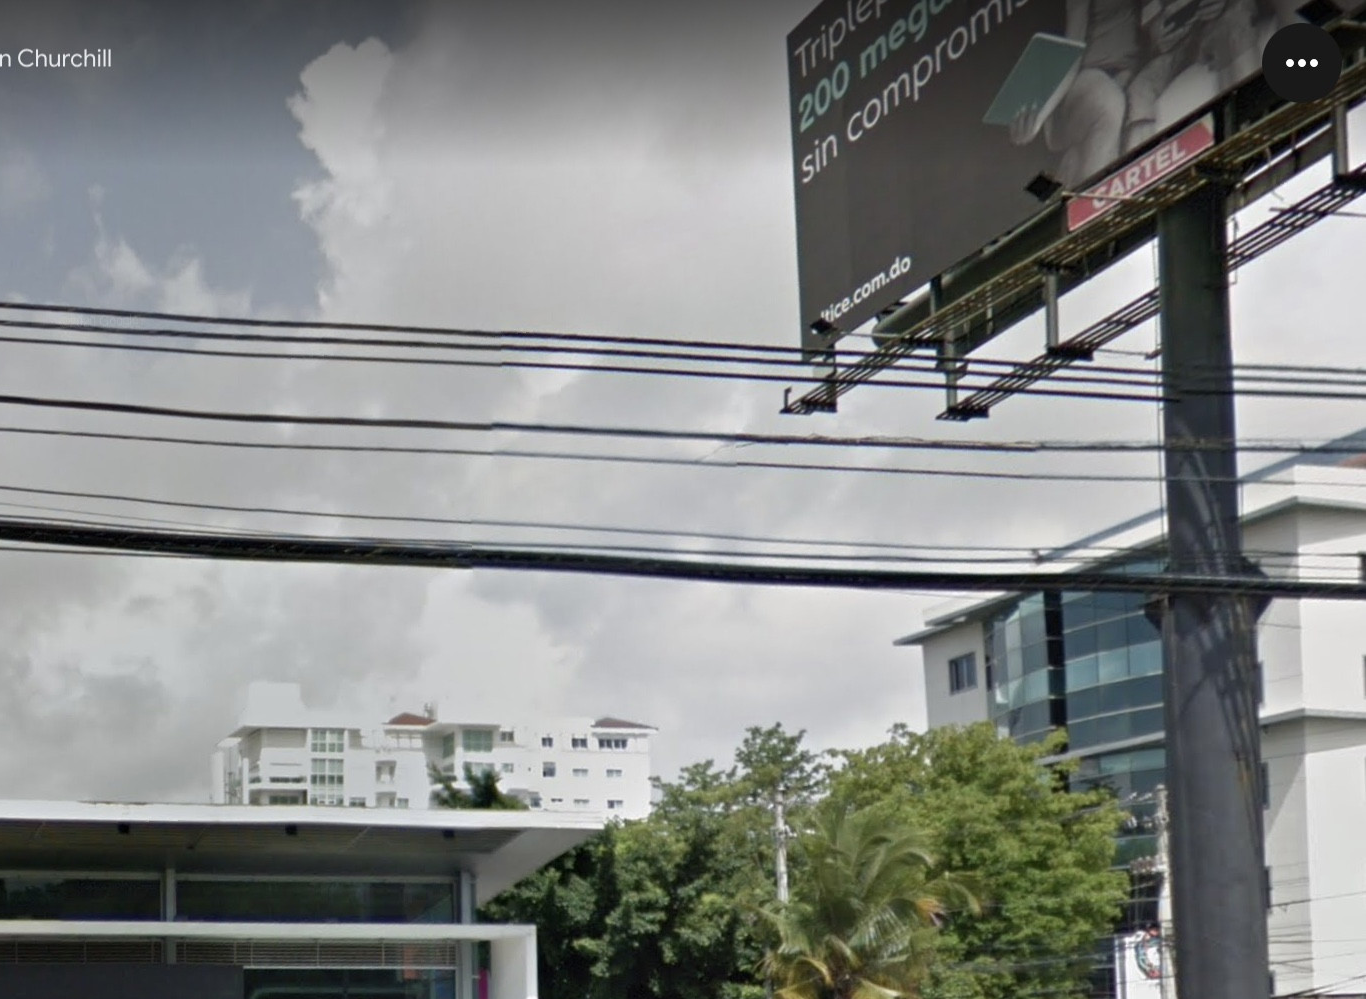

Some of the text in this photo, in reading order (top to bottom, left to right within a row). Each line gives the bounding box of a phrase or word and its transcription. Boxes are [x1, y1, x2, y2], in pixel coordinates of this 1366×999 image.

[798, 60, 850, 133] 200
[801, 0, 1028, 183] sin compromi
[1091, 140, 1186, 209] CARTEL
